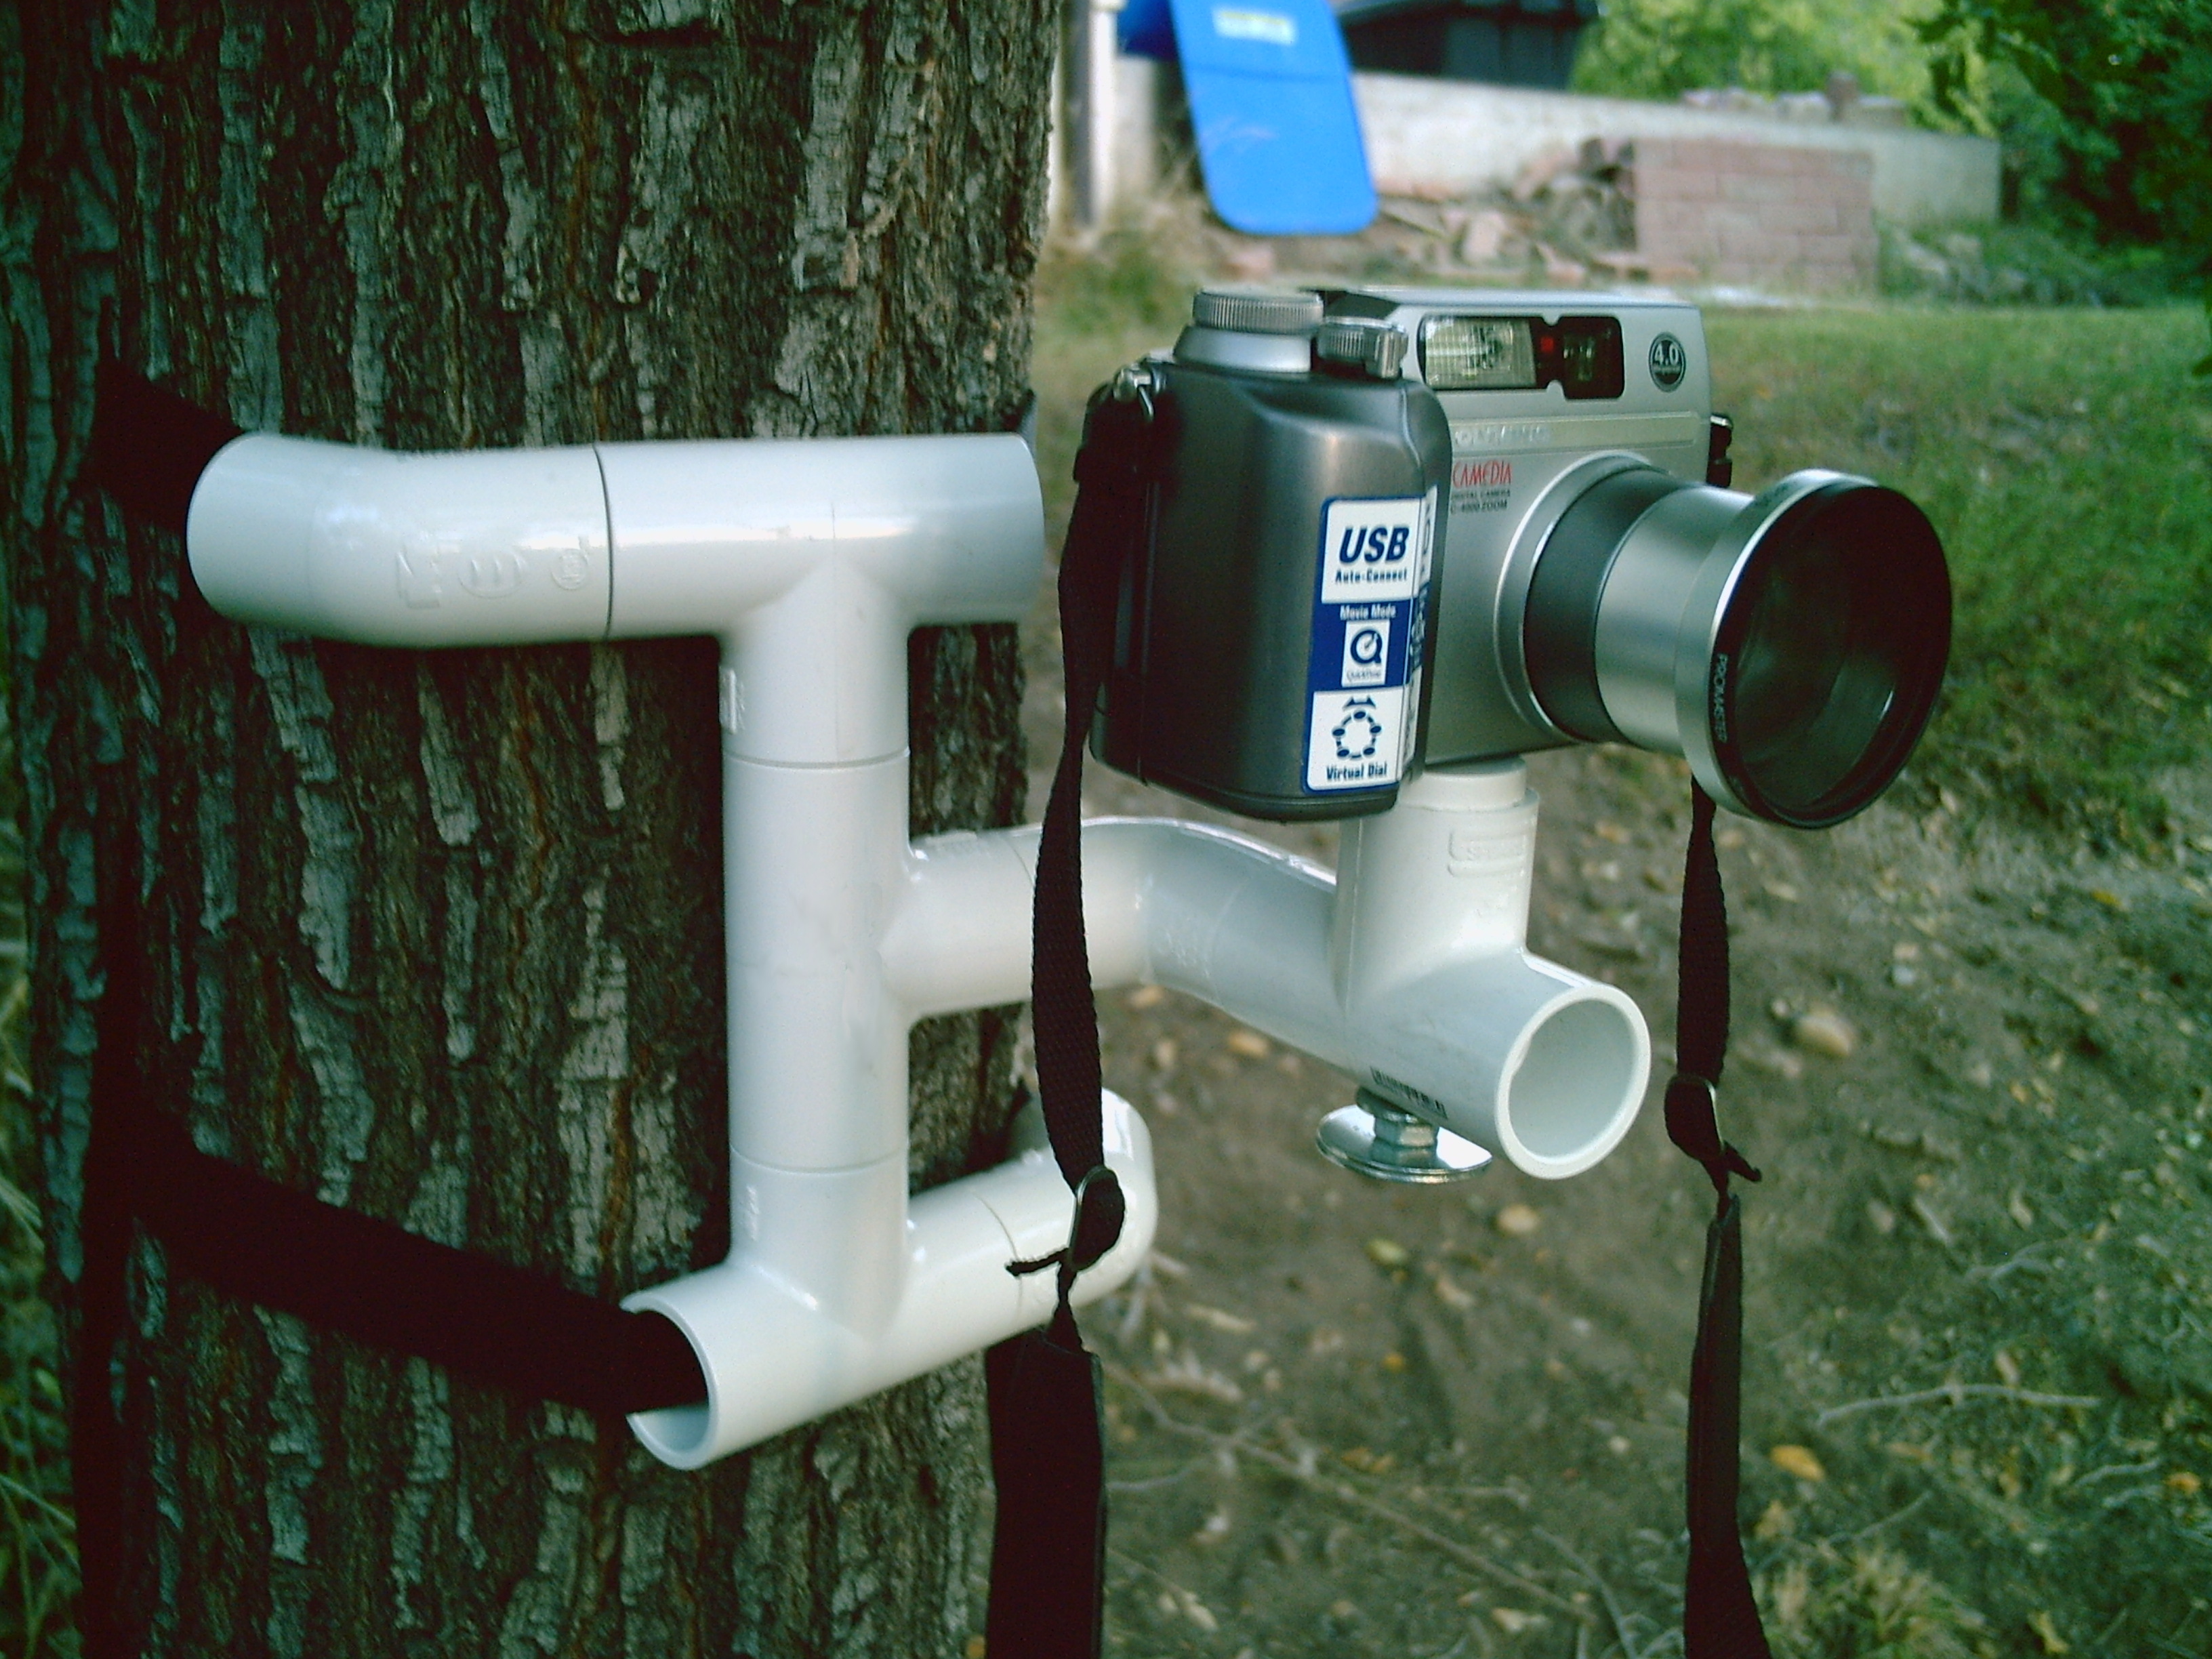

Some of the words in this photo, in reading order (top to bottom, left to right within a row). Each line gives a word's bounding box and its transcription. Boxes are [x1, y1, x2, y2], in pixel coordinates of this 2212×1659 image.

[1655, 344, 1679, 365] 4.0
[1453, 459, 1511, 488] CAMEDIA
[1339, 527, 1410, 563] USB
[1340, 605, 1368, 620] Movie
[1372, 604, 1396, 618] Mode
[1327, 764, 1364, 780] Virtual
[1368, 763, 1387, 778] Dial
